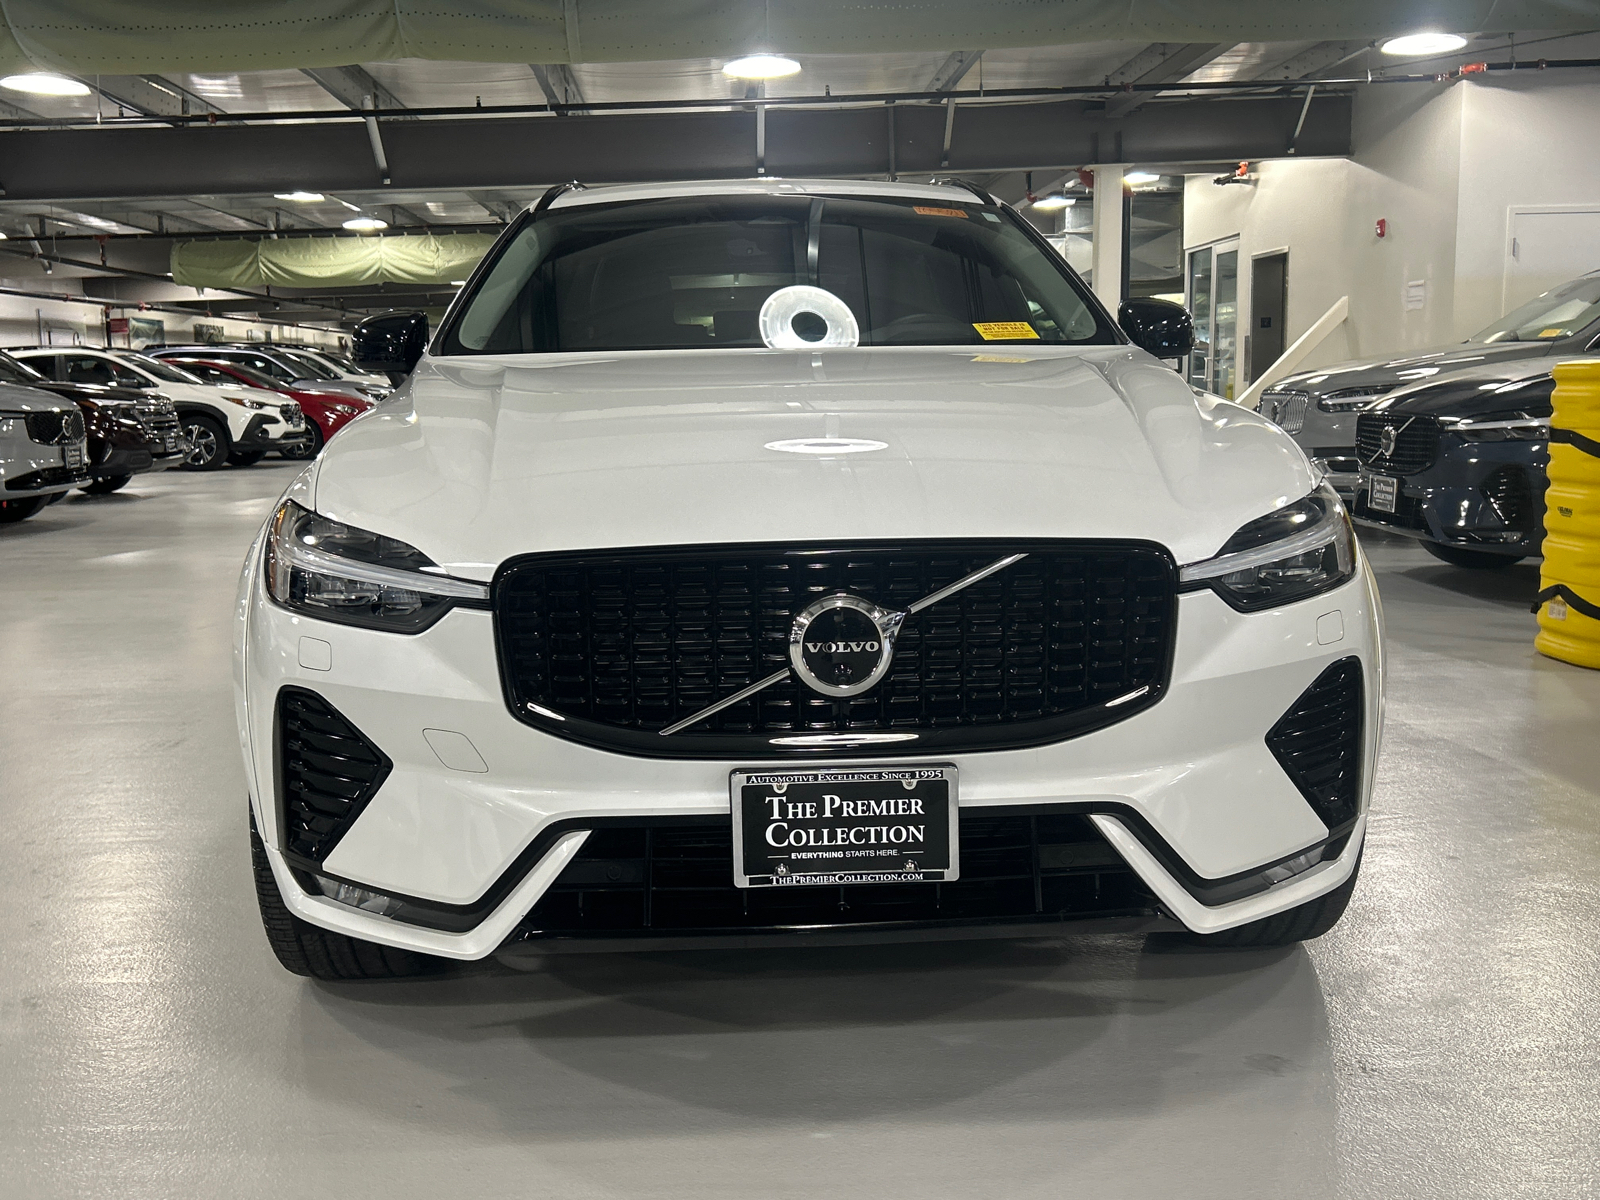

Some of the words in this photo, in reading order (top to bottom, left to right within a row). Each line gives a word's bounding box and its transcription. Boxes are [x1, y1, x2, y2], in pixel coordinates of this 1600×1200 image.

[805, 641, 879, 653] VOLVO
[749, 775, 814, 784] AUTOMOTIVE
[818, 773, 879, 781] EXCELLENCE
[881, 771, 911, 780] SINCE
[914, 770, 942, 779] 1995
[765, 796, 818, 820] THE
[822, 794, 925, 818] PREMIER
[765, 822, 925, 848] COLLECTION
[791, 851, 844, 859] EVERYTHING
[845, 850, 875, 858] STARTS
